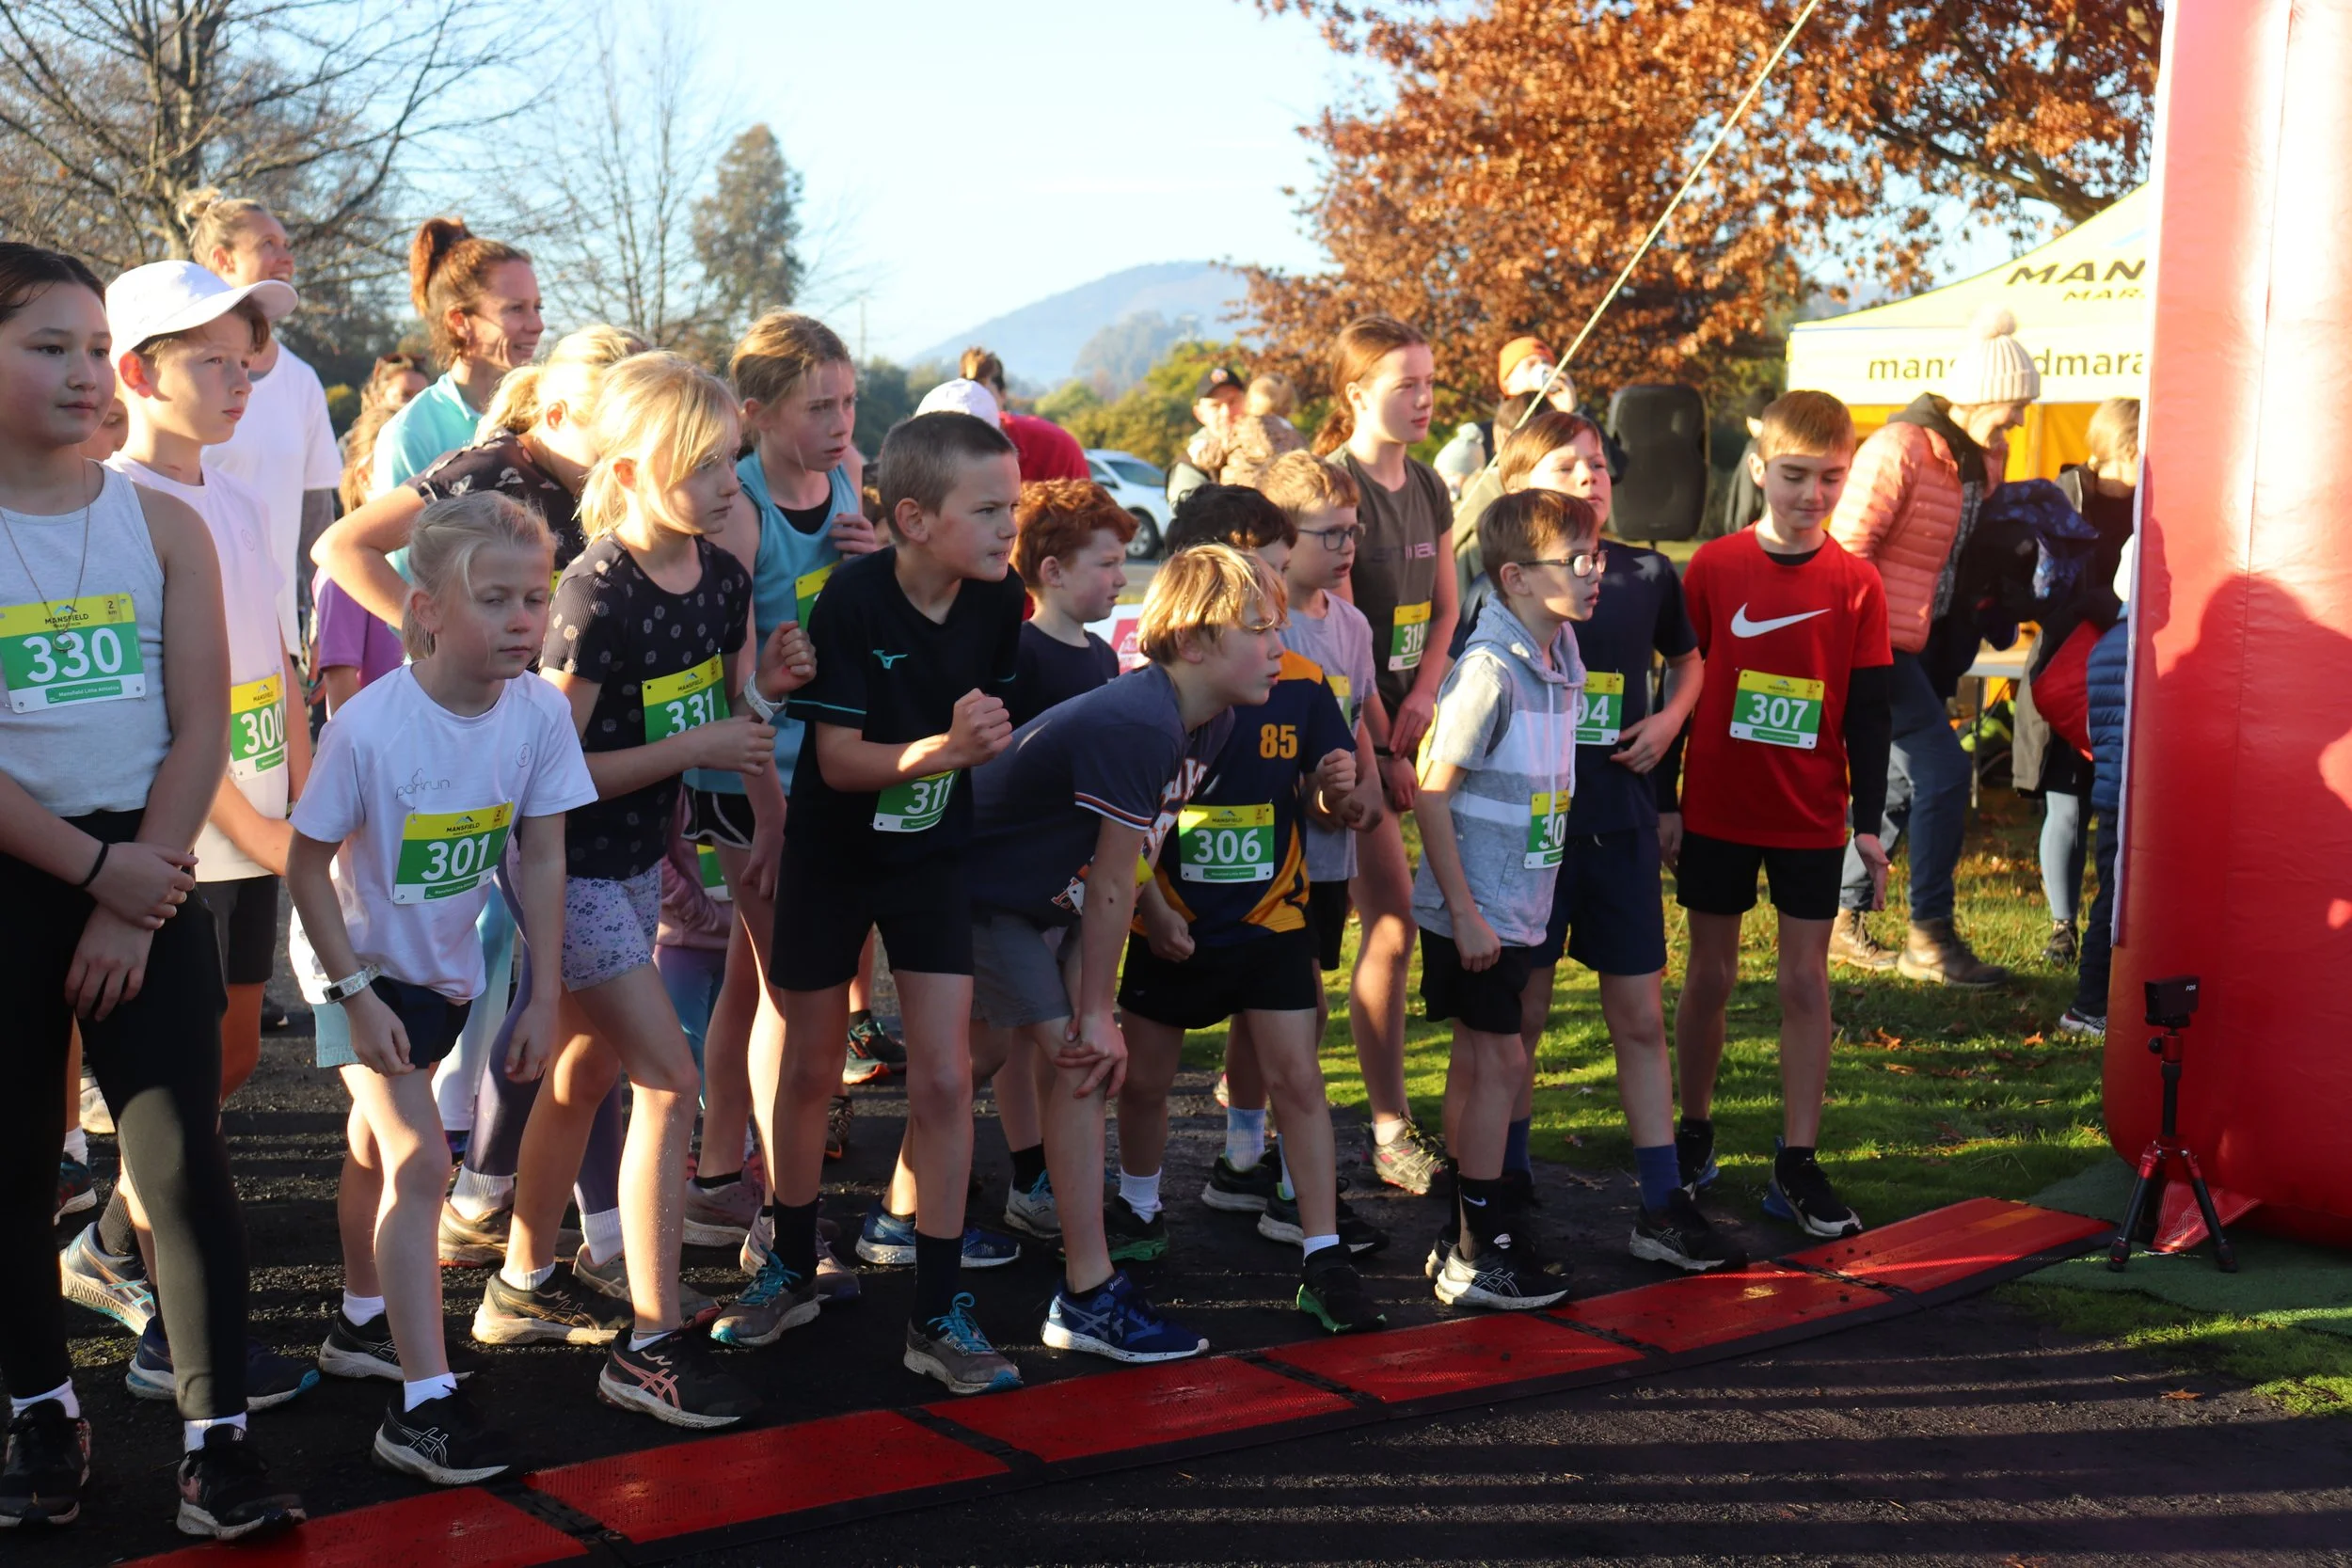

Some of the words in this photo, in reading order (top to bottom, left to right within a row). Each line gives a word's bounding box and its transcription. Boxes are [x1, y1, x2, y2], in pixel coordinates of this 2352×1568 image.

[44, 613, 89, 625] MANSFIELD
[107, 600, 114, 610] 2
[23, 627, 122, 683] 330
[240, 703, 284, 754] 300
[665, 688, 715, 737] 331
[1747, 693, 1809, 730] 307
[1260, 723, 1297, 759] 85
[395, 768, 451, 800] parkrun
[904, 773, 954, 815] 311
[446, 822, 481, 832] MANSFIELD
[1193, 828, 1262, 863] 306
[1537, 811, 1568, 850] 30
[421, 833, 491, 881] 301
